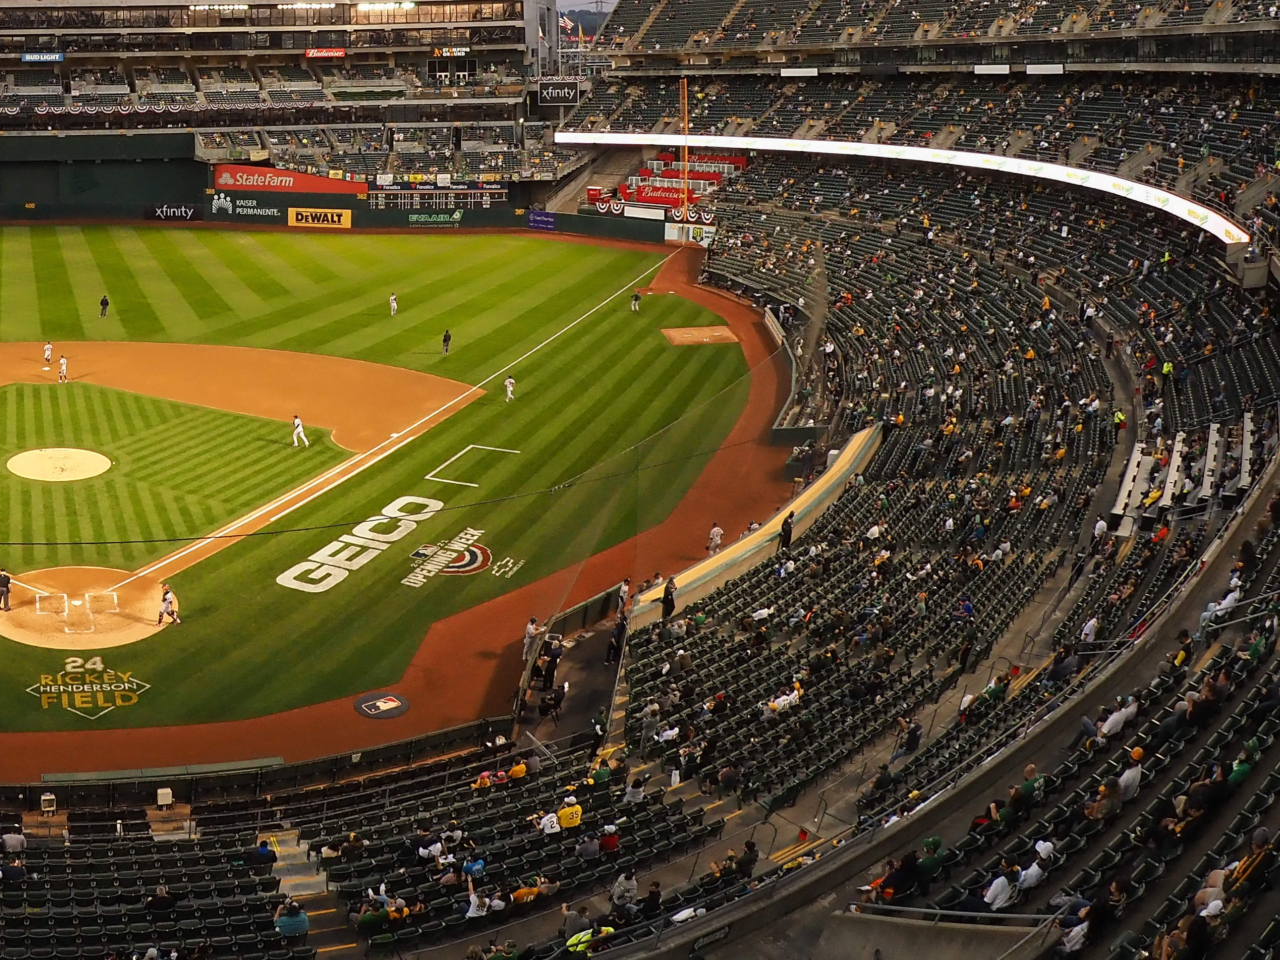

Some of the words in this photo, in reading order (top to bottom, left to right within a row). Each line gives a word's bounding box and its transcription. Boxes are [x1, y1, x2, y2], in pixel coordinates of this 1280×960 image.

[307, 49, 344, 57] Budweiser
[541, 86, 576, 100] xfinity
[236, 199, 257, 207] KAISER
[155, 205, 194, 219] xfinity
[693, 227, 703, 237] 811
[275, 495, 445, 593] GEICO
[400, 550, 458, 588] OPENING
[444, 527, 486, 551] WEEK
[64, 656, 105, 673] 24
[40, 671, 132, 685] RICKEY
[40, 682, 137, 693] HENDERSON
[41, 691, 139, 709] FIELD
[569, 810, 579, 820] 35
